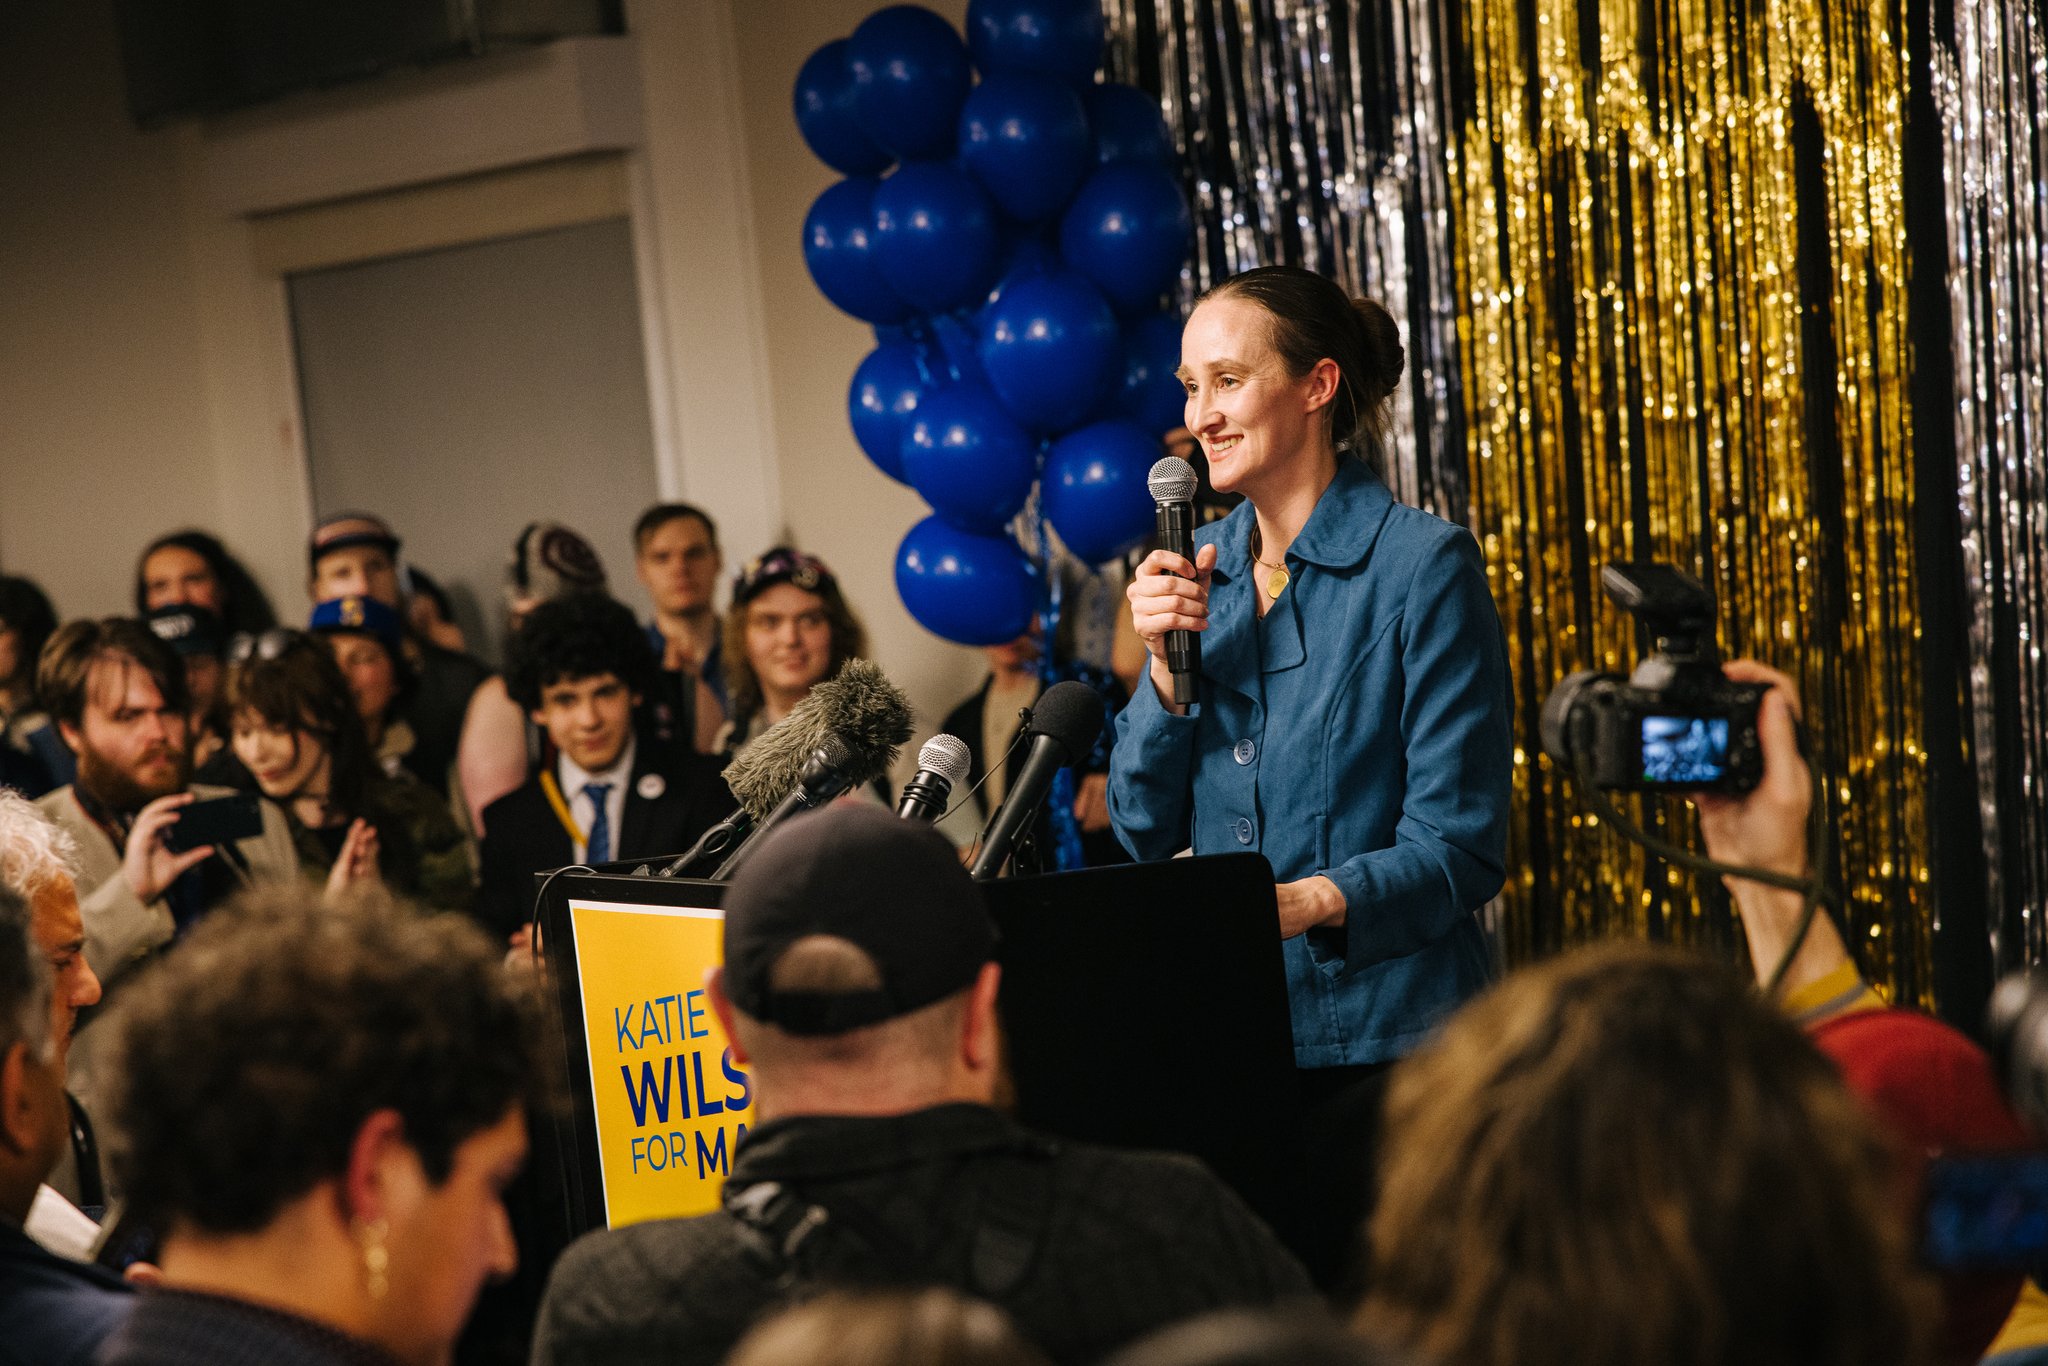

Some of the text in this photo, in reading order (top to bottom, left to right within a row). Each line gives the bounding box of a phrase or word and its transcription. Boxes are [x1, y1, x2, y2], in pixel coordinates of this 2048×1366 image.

[615, 989, 708, 1053] KATIE
[621, 1045, 752, 1127] WILS
[631, 1131, 688, 1174] FOR
